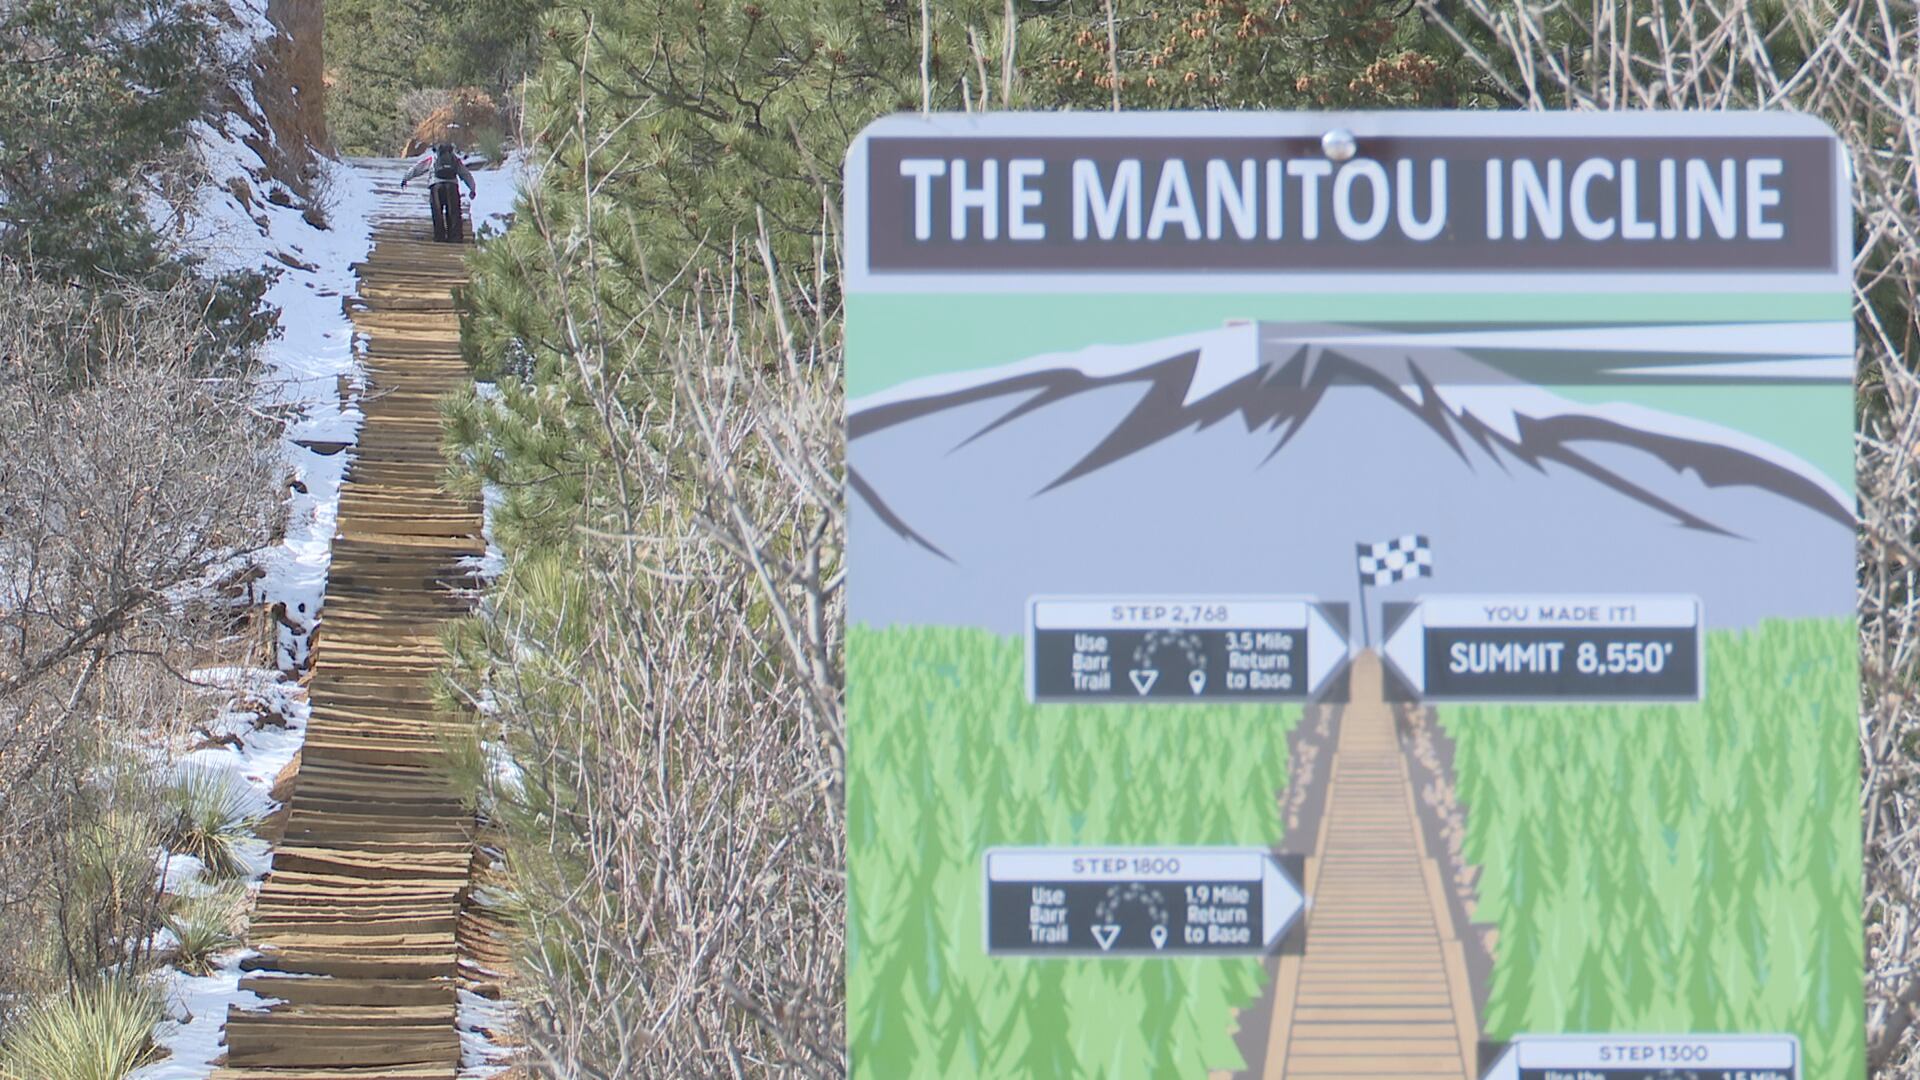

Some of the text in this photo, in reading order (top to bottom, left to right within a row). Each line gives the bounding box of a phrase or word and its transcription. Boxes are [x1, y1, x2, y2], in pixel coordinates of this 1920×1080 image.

[900, 157, 1784, 241] THE MANITOU INCLINE
[1111, 606, 1228, 623] STEP 2,768
[1484, 606, 1636, 622] YOU MADE IT!
[1074, 634, 1108, 651] Use
[1226, 632, 1293, 650] 3.5 Mile
[1072, 653, 1109, 671] Barr
[1229, 652, 1289, 670] Return
[1450, 642, 1673, 676] SUMMIT 8,550'
[1072, 672, 1111, 690] Trail
[1226, 671, 1291, 689] to Base
[1072, 858, 1180, 874] STEP 1800
[1032, 887, 1066, 904] Use
[1185, 886, 1249, 903] 1.9 Mile
[1030, 906, 1067, 923] Barr
[1187, 905, 1247, 923] Return
[1030, 925, 1068, 943] Trail
[1184, 925, 1250, 943] to Base
[1600, 1046, 1708, 1061] STEP 1300
